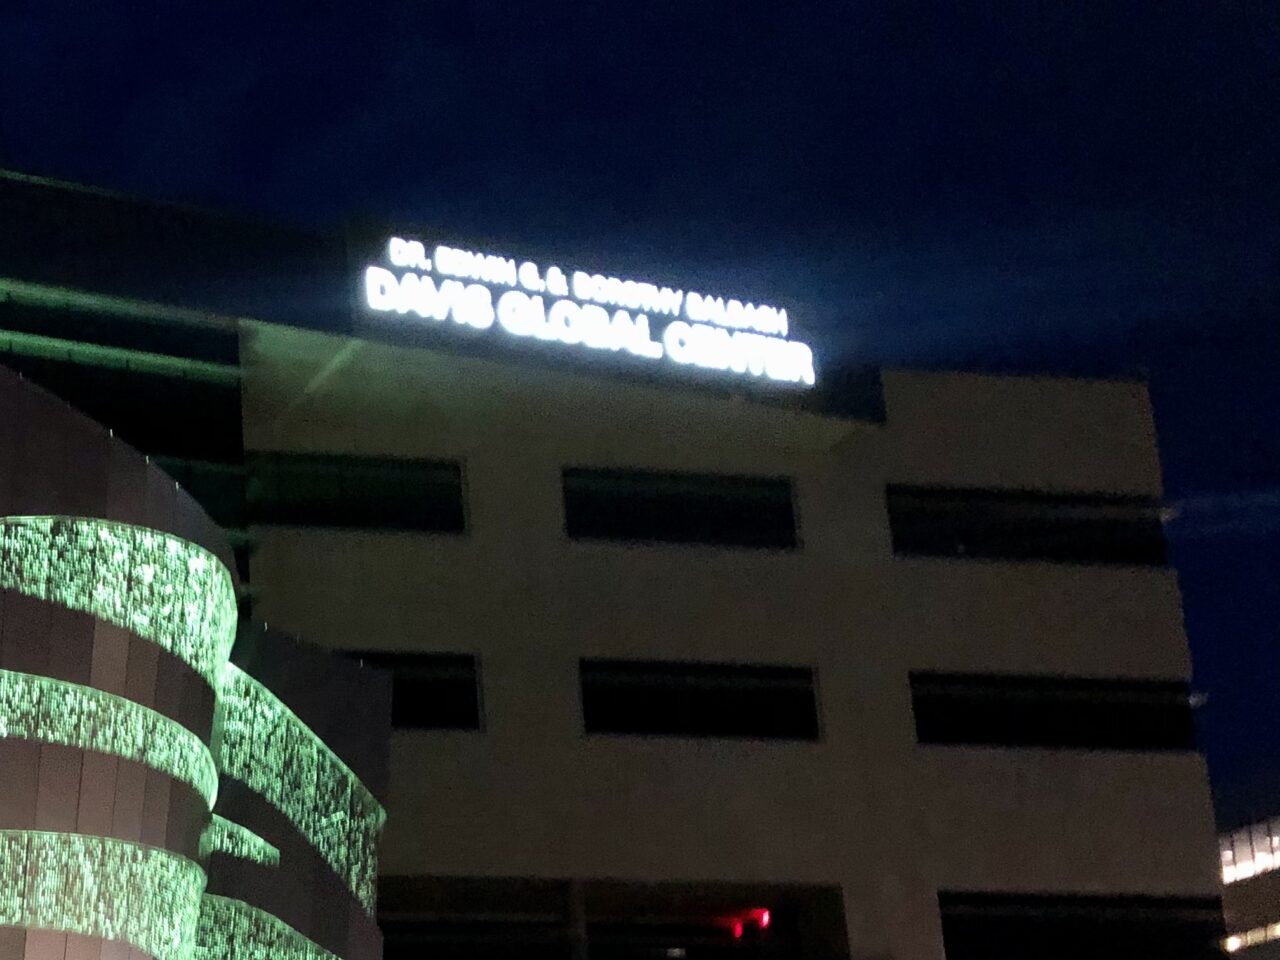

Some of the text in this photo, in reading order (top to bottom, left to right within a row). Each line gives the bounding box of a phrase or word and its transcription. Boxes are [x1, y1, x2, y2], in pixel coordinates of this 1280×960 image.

[365, 266, 816, 385] DAVIS GLOBAL CENTER
